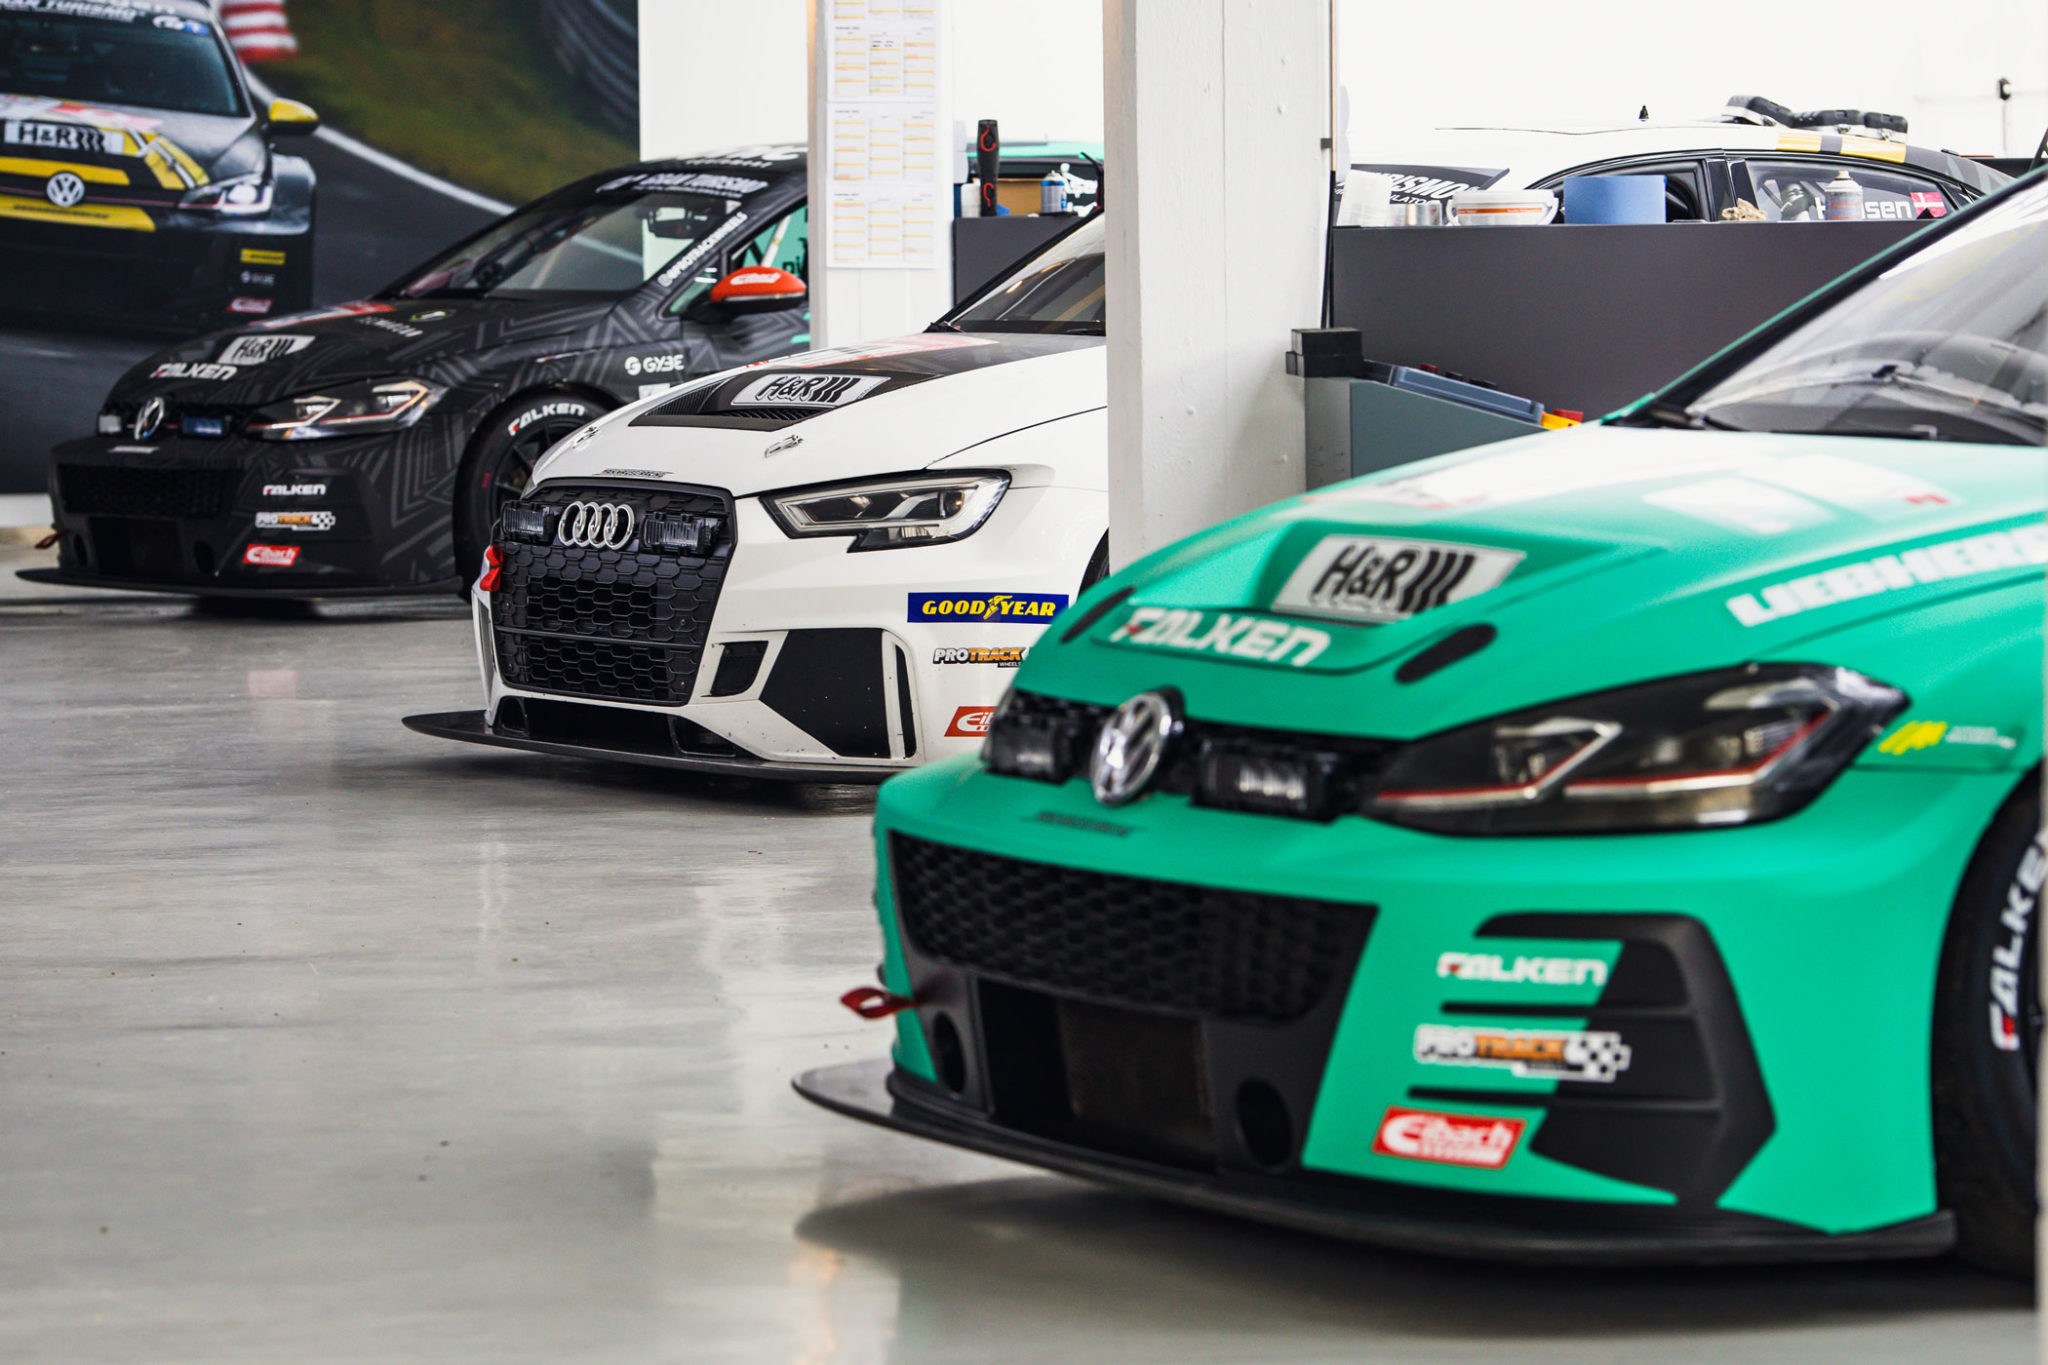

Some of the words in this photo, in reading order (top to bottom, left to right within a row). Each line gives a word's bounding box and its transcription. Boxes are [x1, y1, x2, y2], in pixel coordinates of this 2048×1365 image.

[1383, 173, 1471, 199] RISMO
[150, 362, 237, 381] FALKEN
[755, 375, 829, 402] H&R
[508, 402, 586, 437] FALKEN
[262, 484, 327, 497] FALKEN
[1308, 543, 1420, 604] H&R
[1109, 607, 1331, 667] FALKEN
[933, 648, 1025, 664] PROTRACK
[1436, 951, 1608, 987] FALKEN
